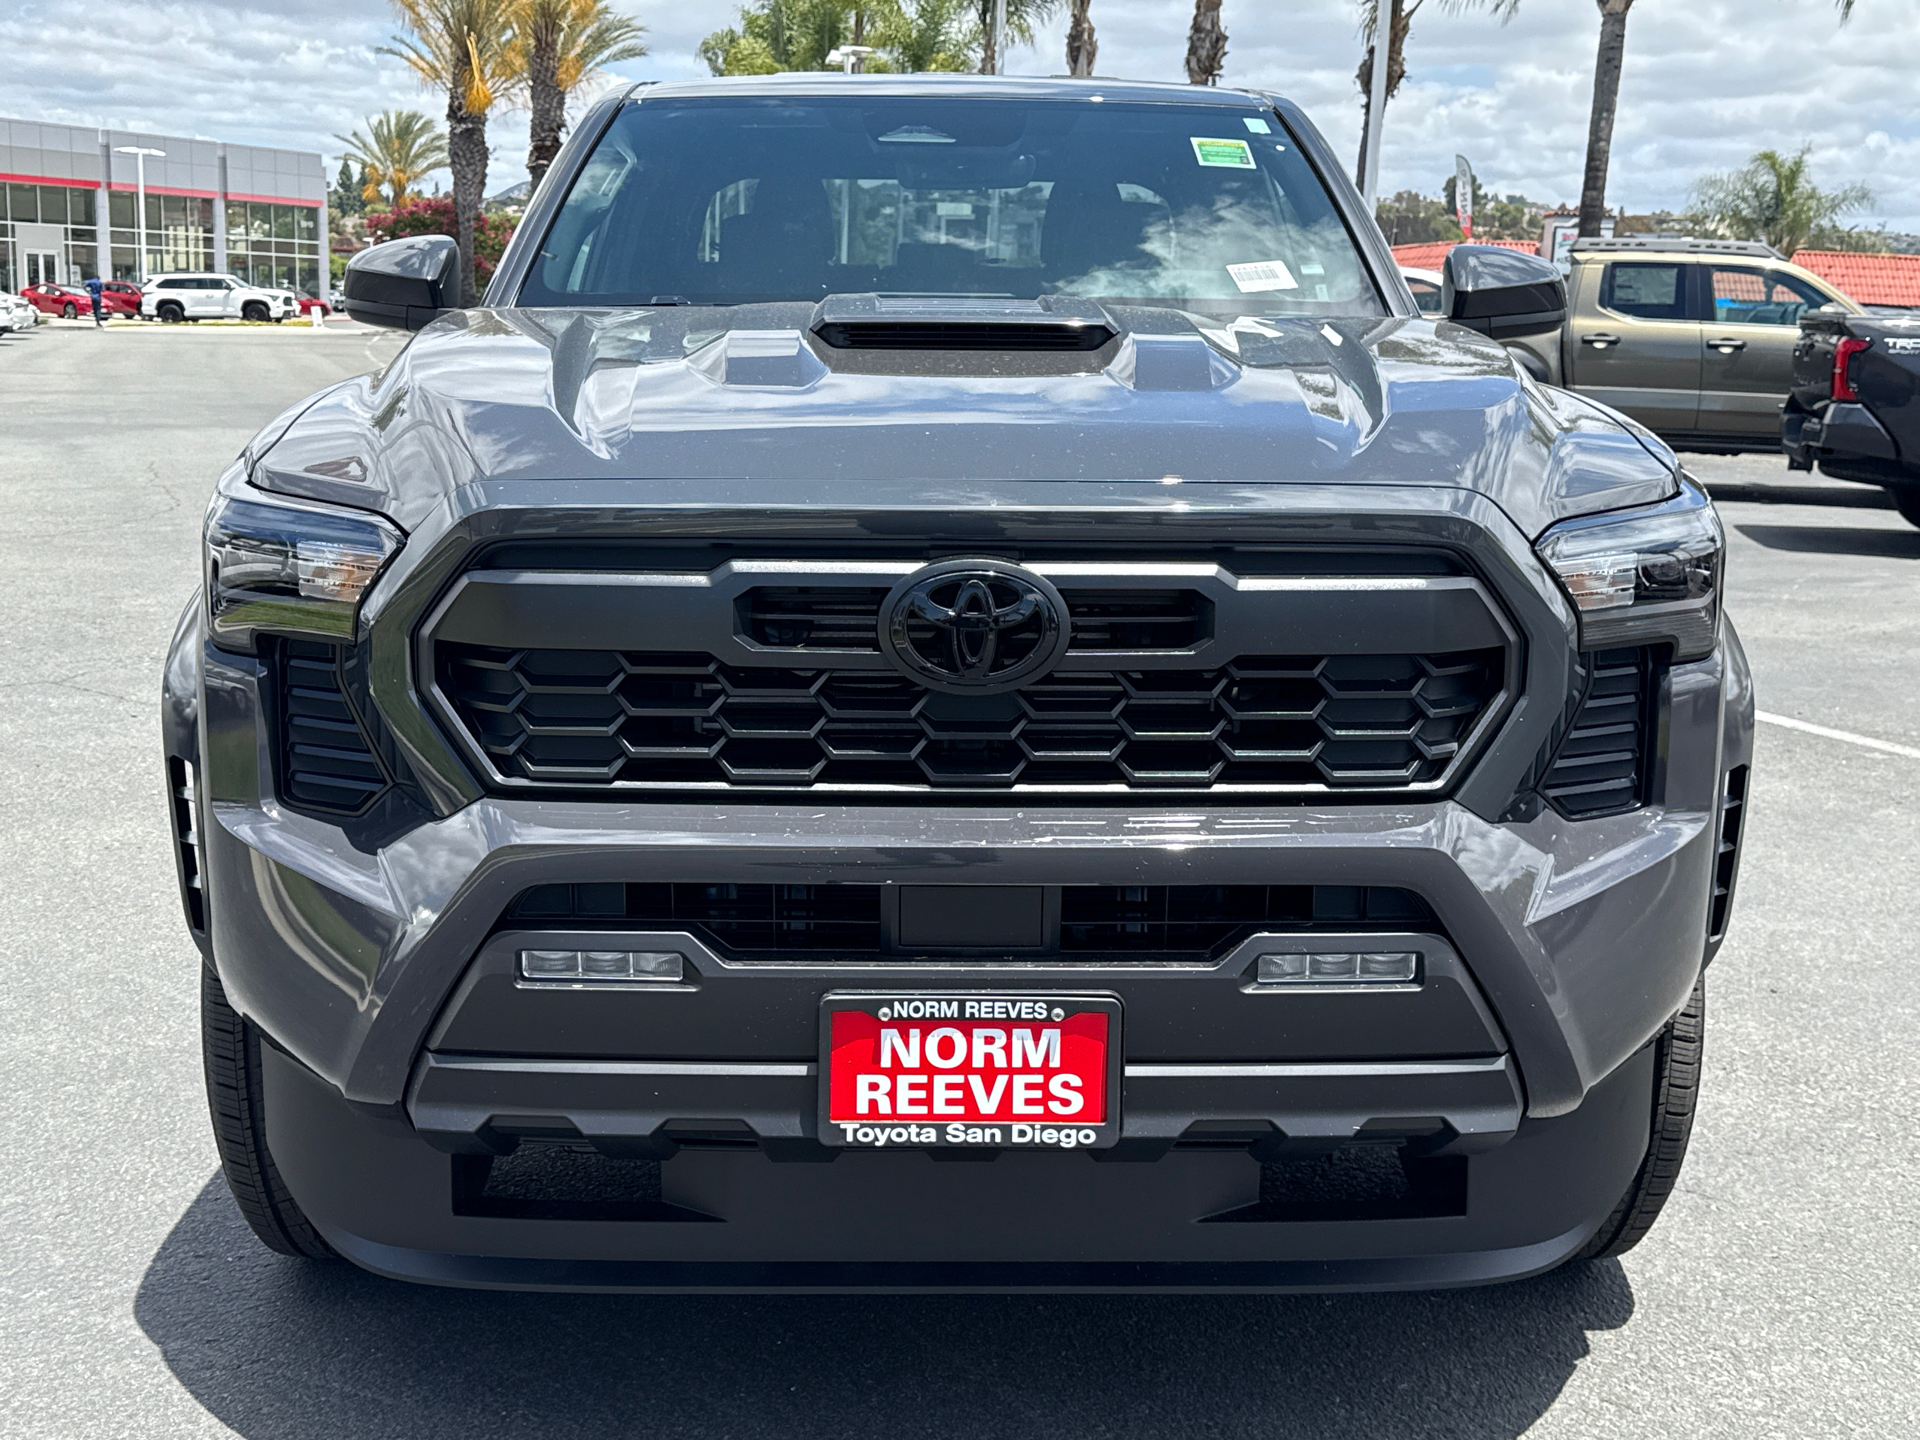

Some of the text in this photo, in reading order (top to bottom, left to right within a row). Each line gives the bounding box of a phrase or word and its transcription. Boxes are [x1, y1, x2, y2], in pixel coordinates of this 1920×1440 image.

[893, 1001, 1048, 1019] NORM REEVES
[880, 1027, 1061, 1069] NORM
[856, 1073, 1085, 1115] REEVES
[839, 1123, 1097, 1148] Toyota San Diego
